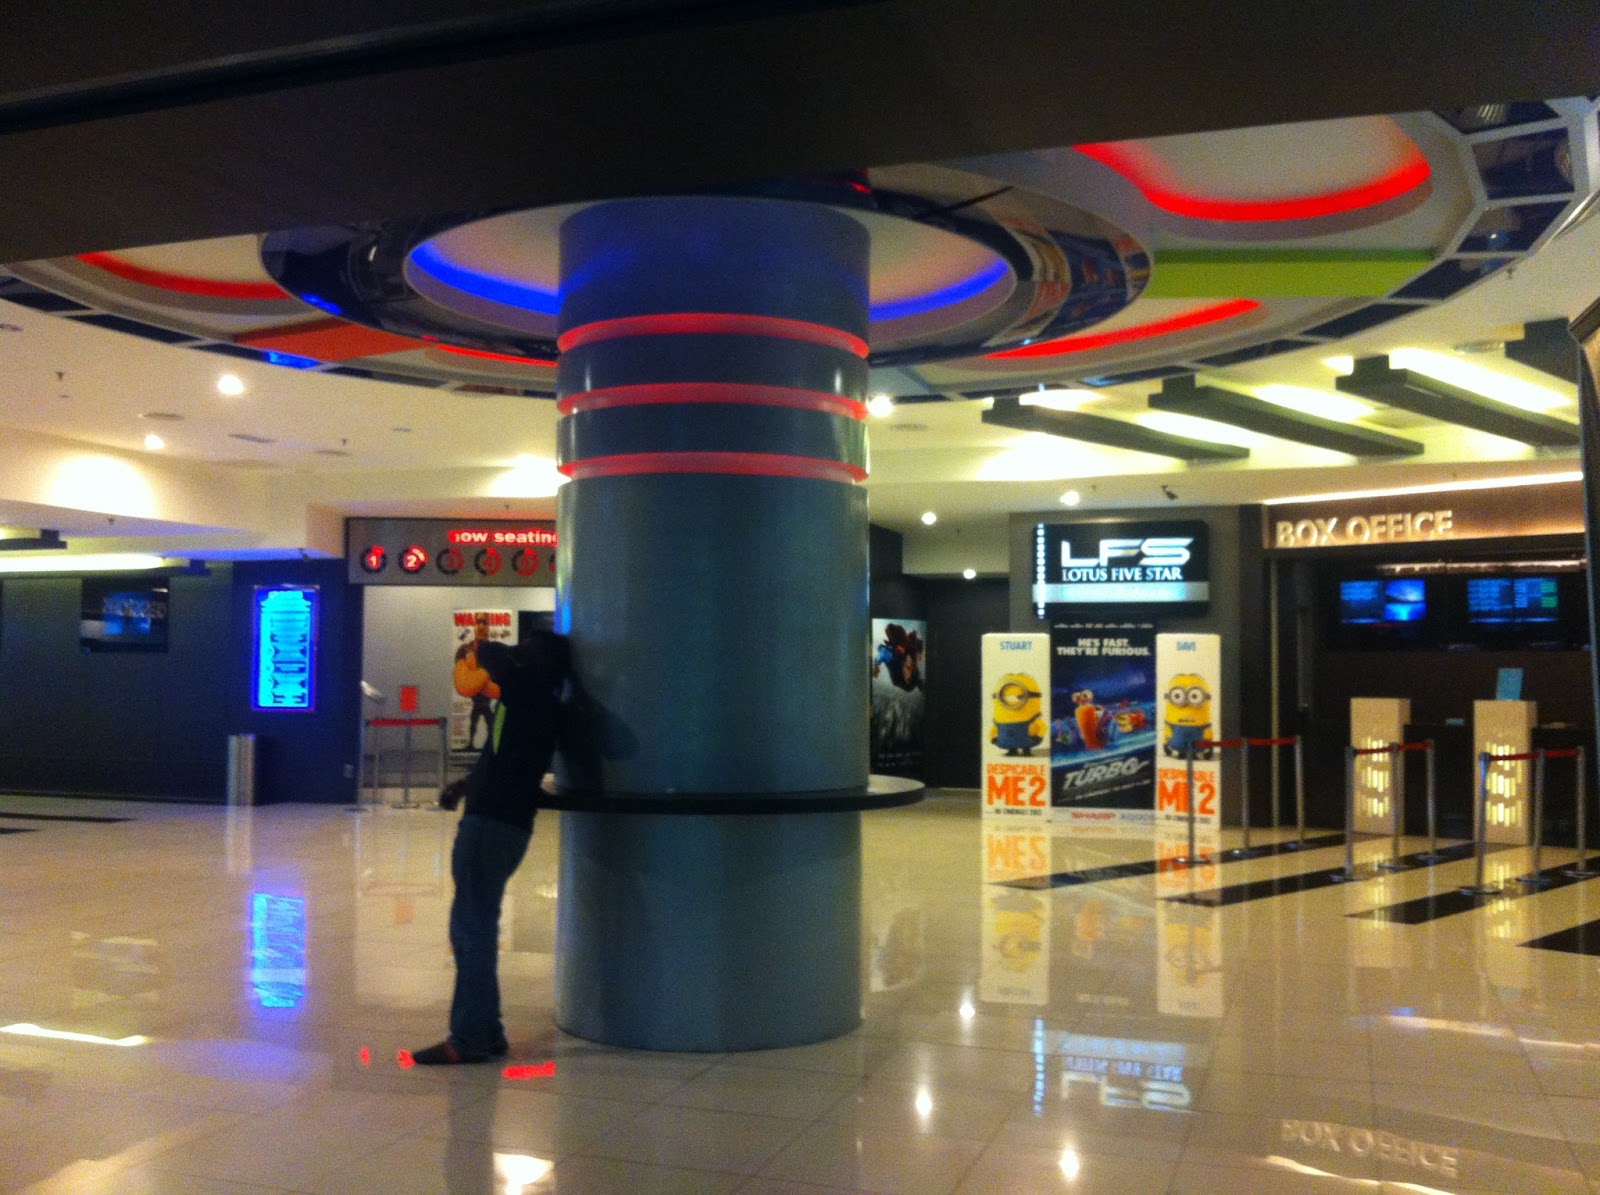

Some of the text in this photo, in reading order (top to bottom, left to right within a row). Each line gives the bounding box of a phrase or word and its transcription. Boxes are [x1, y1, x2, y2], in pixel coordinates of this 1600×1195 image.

[1276, 510, 1453, 547] BOX OFFICE
[494, 531, 557, 546] seatin
[1061, 538, 1194, 567] LFS
[406, 555, 418, 567] 2
[1062, 567, 1182, 581] LOTUS FIVE STAR
[454, 612, 511, 626] WAING
[1000, 641, 1032, 650] STUART
[1063, 757, 1150, 790] TURBO
